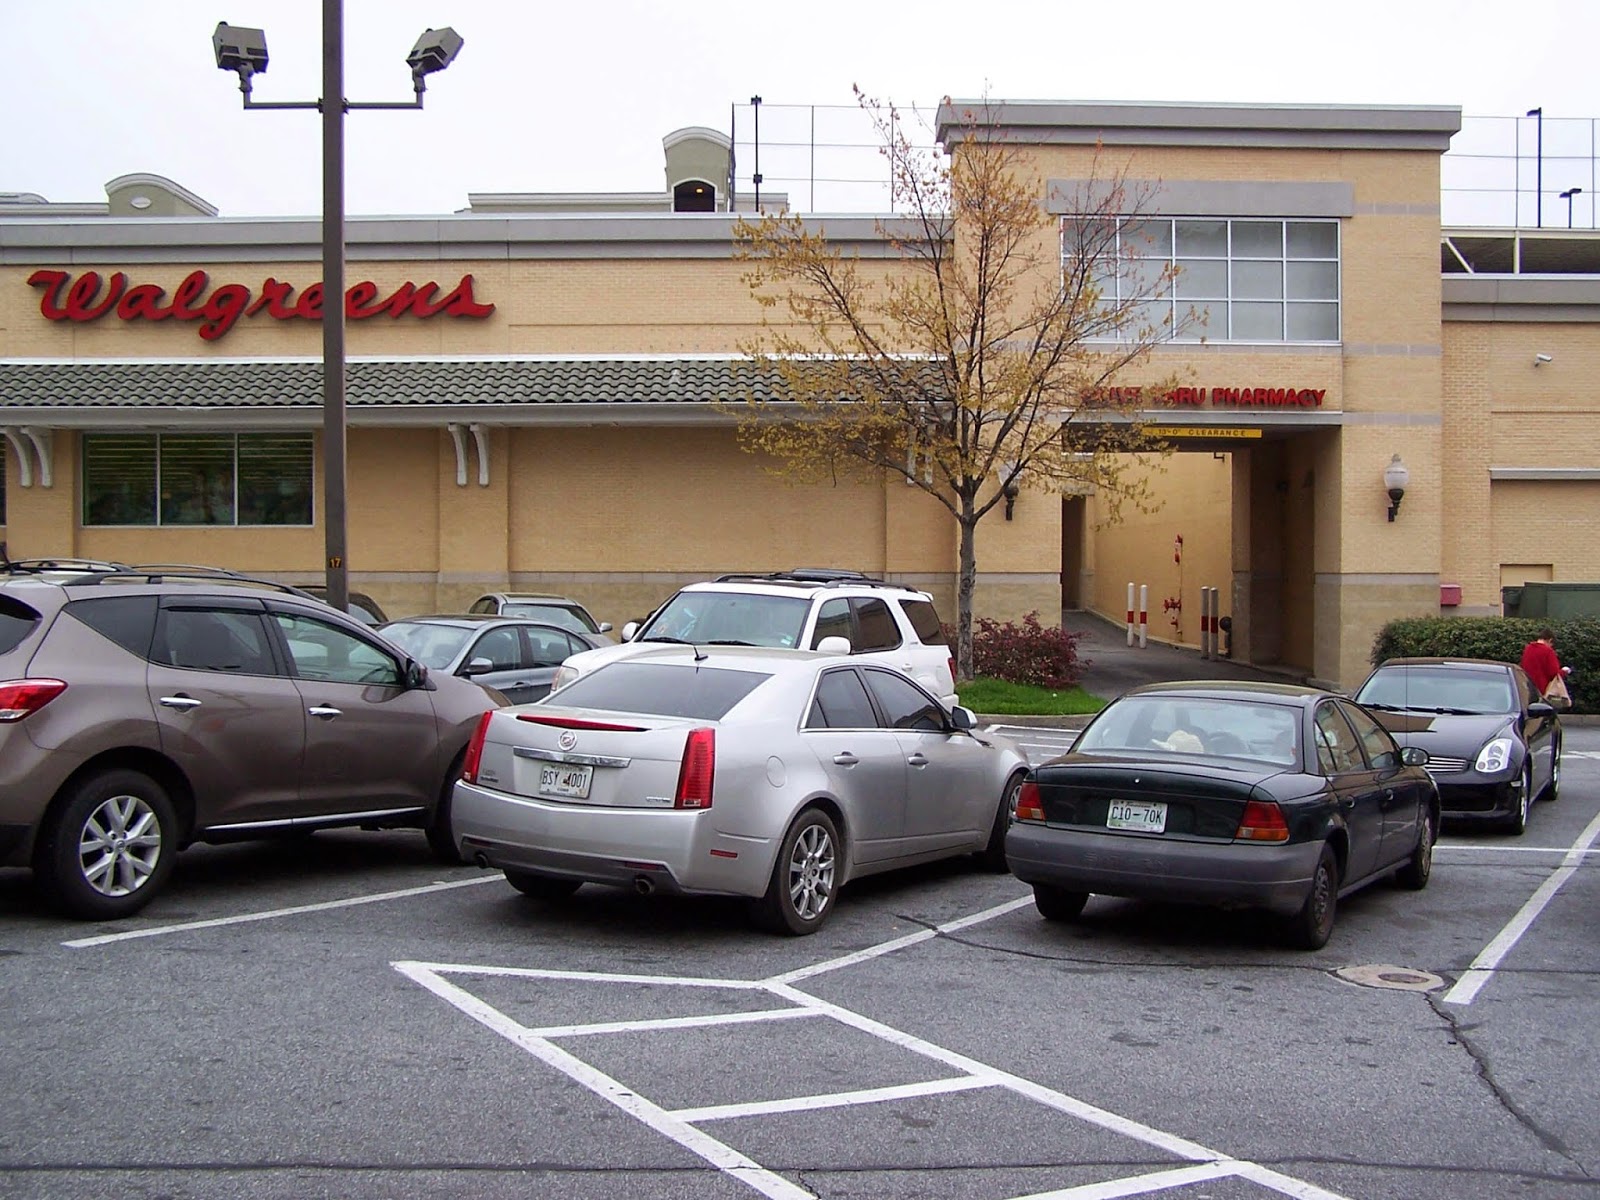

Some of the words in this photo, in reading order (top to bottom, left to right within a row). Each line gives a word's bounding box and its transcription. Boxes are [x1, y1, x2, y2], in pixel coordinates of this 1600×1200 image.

[27, 270, 496, 341] Walgreens
[1151, 387, 1206, 404] HRU
[1212, 388, 1326, 406] PHARMACY
[1187, 429, 1247, 437] CLEARANCE
[330, 556, 342, 568] 17
[542, 770, 560, 785] BSY
